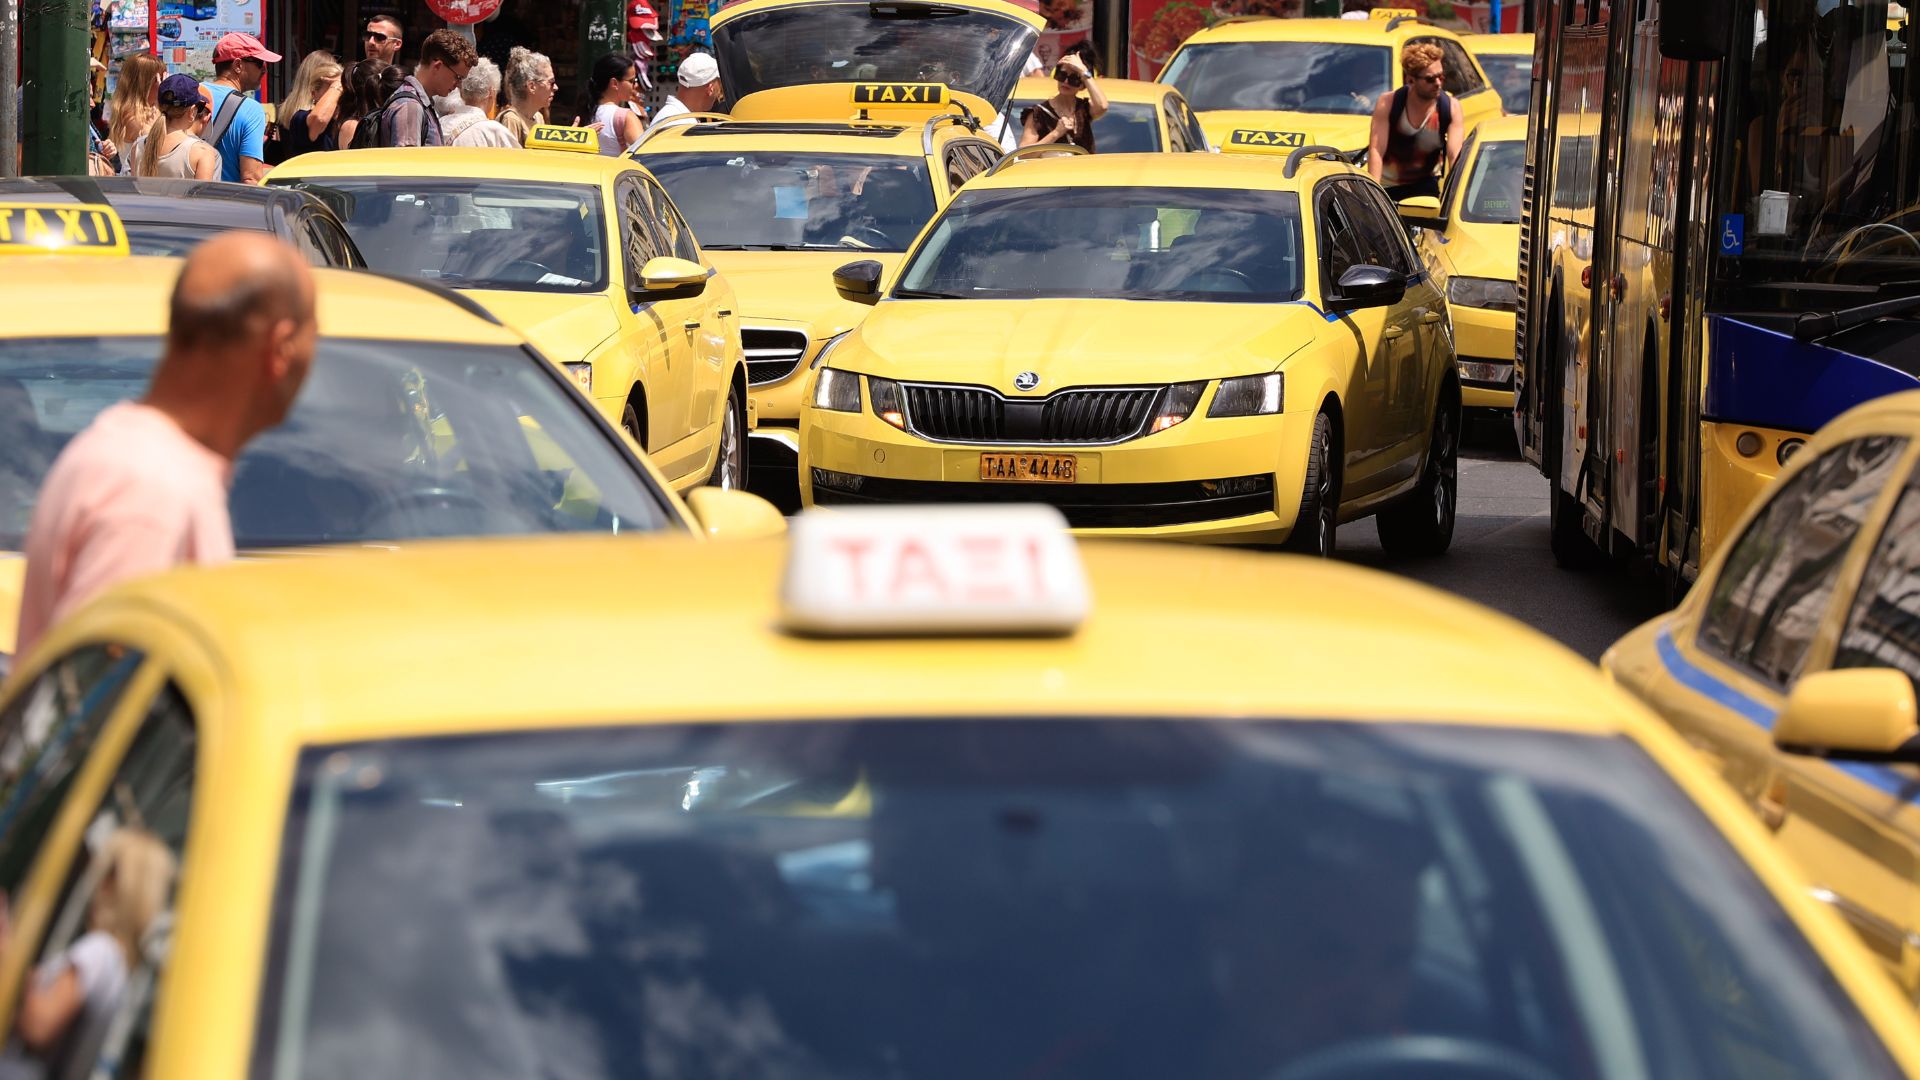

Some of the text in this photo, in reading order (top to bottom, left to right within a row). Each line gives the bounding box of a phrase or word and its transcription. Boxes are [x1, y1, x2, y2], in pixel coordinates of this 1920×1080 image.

[865, 86, 930, 102] TAXI
[538, 128, 586, 142] TAXI
[1236, 130, 1302, 146] TAXI
[1029, 458, 1073, 479] 4448
[829, 534, 1053, 602] ΤΑΞΙ
